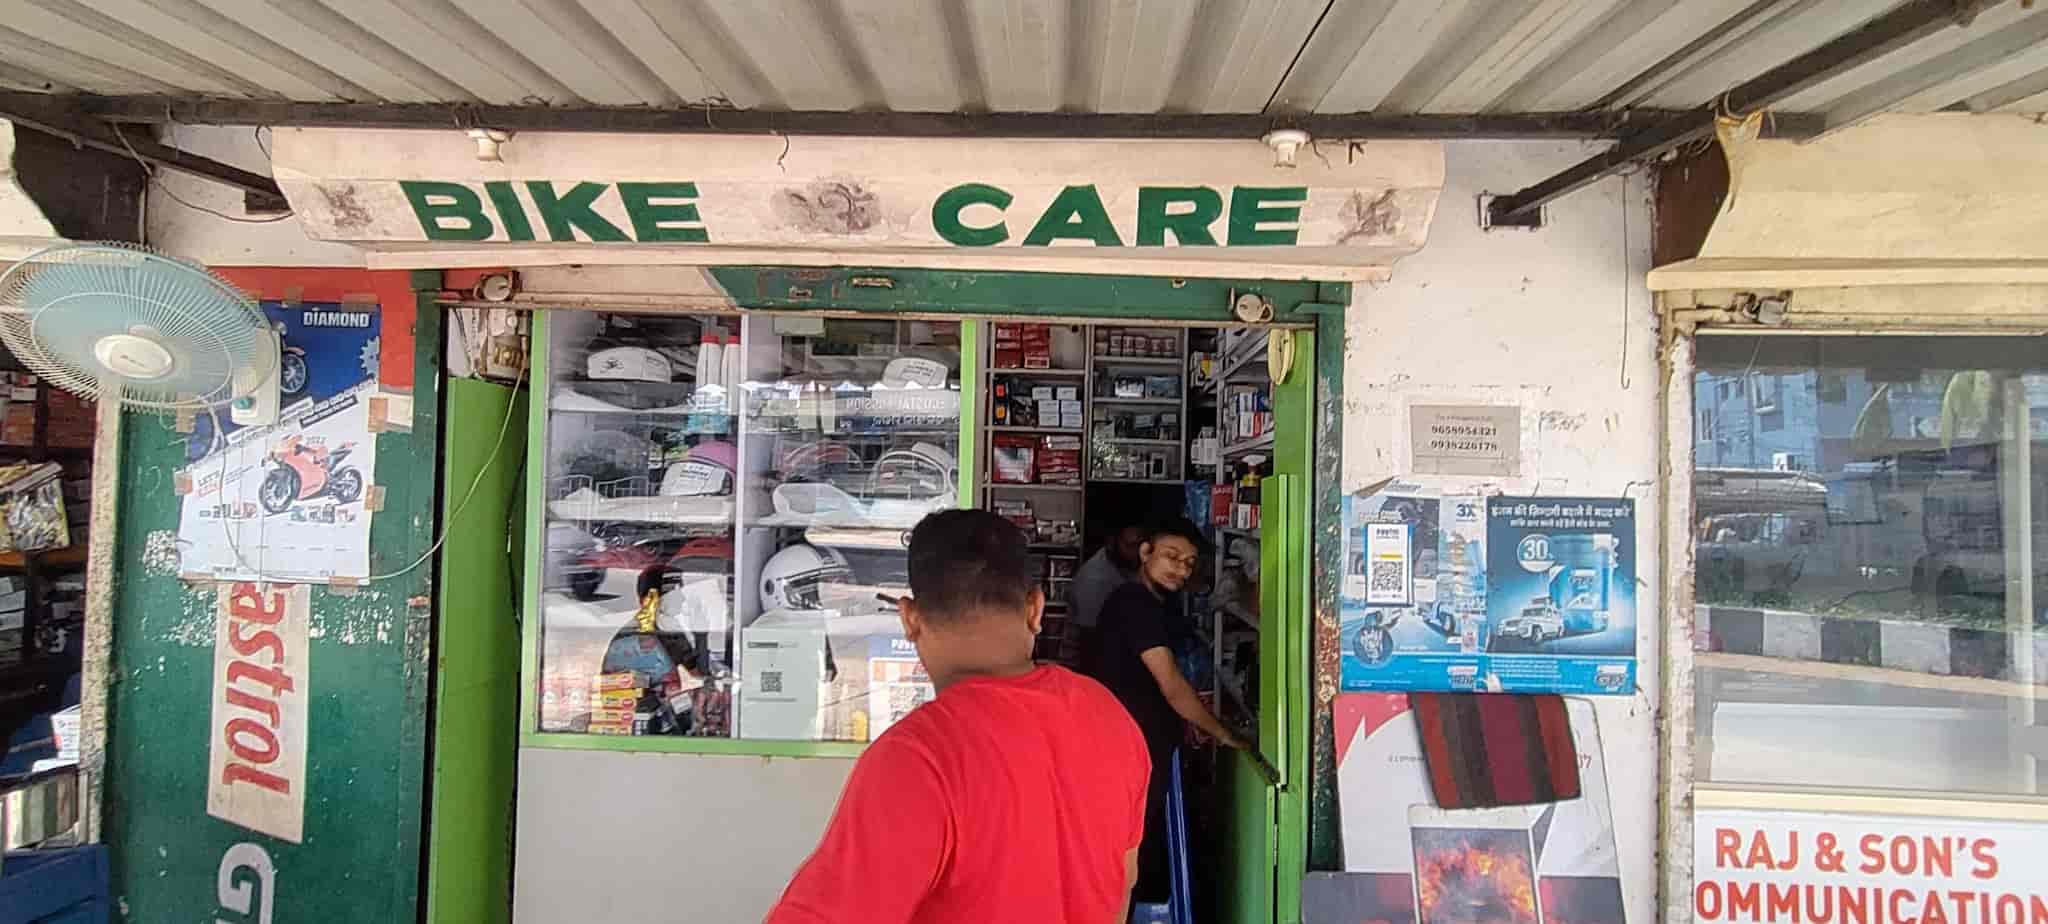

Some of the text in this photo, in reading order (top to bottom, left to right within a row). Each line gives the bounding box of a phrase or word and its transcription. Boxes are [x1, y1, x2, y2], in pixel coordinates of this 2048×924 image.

[398, 180, 1309, 247] BIKE CARE
[222, 582, 295, 795] astrol
[216, 841, 277, 924] G
[1715, 828, 1999, 879] RAJ & SON'S
[1695, 880, 2048, 924] OMMUNICATION
